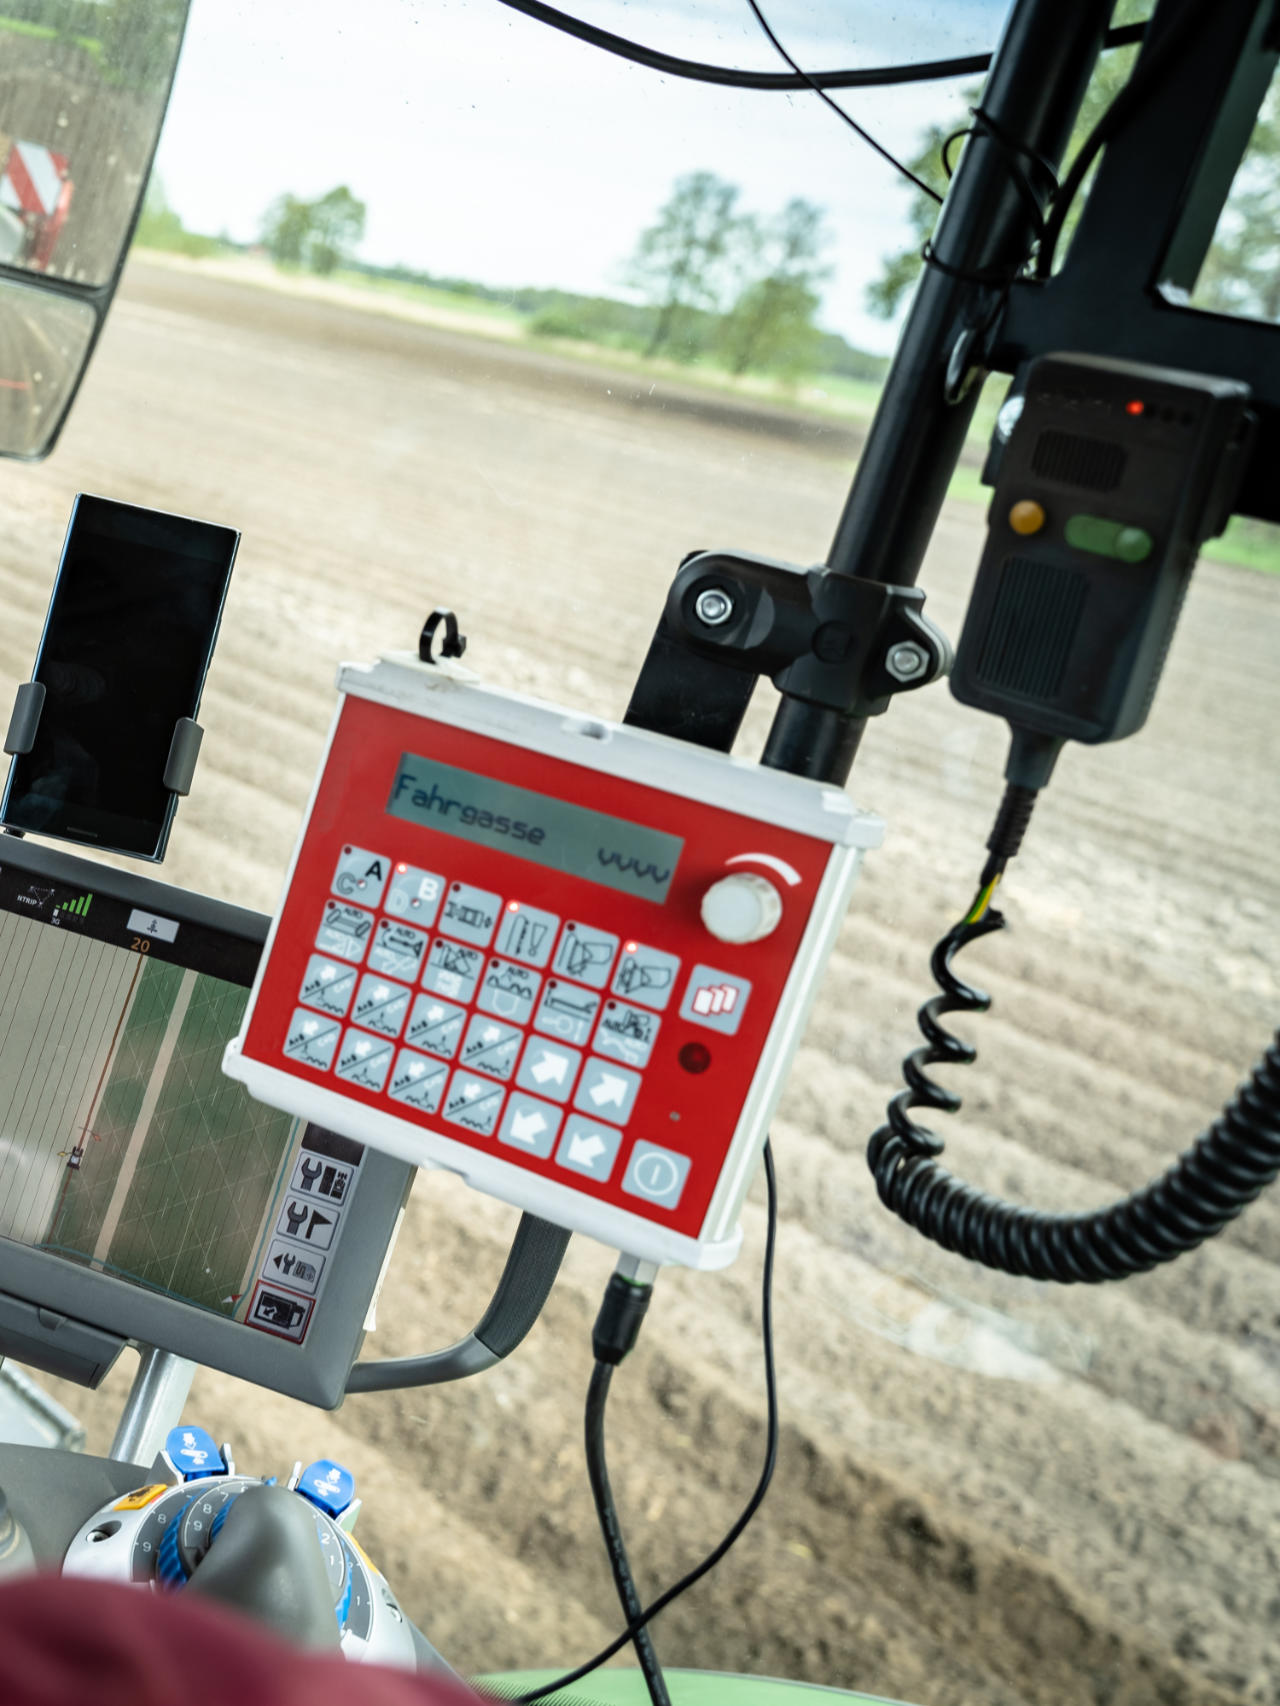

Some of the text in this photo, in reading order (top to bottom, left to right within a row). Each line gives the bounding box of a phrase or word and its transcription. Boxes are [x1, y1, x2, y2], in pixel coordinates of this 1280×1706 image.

[394, 773, 546, 846] Fahrgasse
[365, 860, 383, 882] A
[336, 872, 356, 895] C
[418, 877, 439, 901] B
[131, 936, 150, 953] 20
[203, 1503, 212, 1514] 8
[157, 1513, 167, 1524] 8
[193, 1520, 203, 1532] 9
[321, 1532, 330, 1545] 2
[142, 1541, 152, 1552] 9
